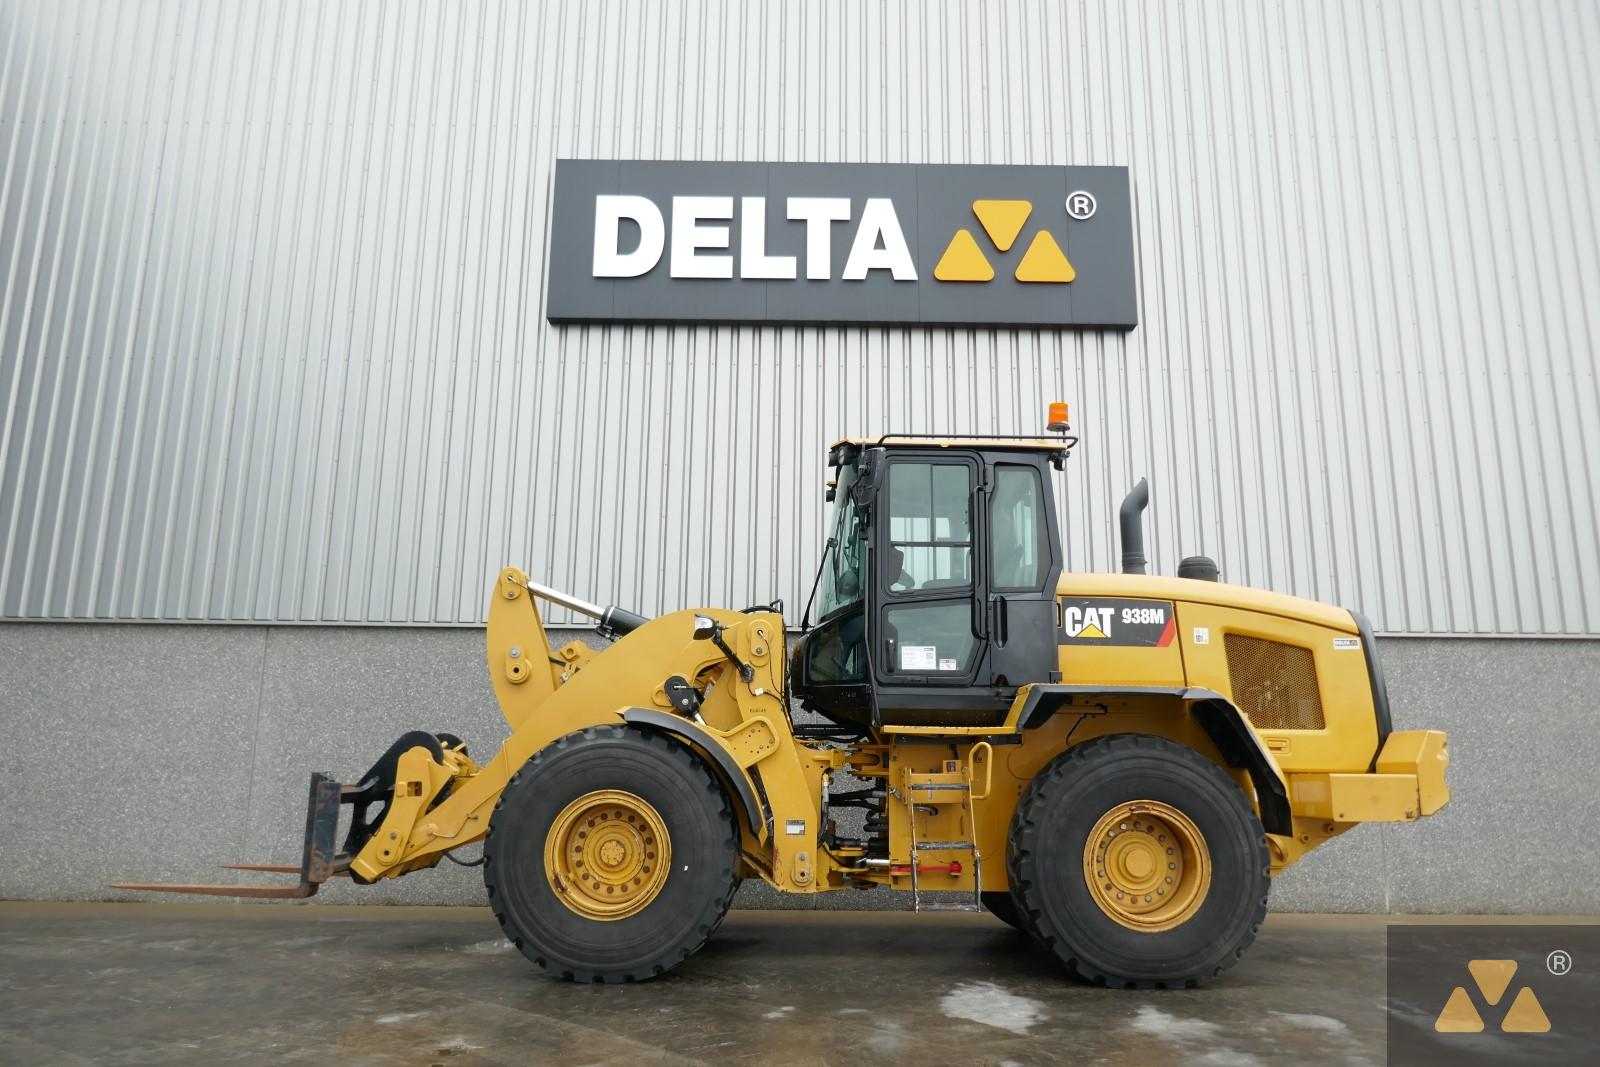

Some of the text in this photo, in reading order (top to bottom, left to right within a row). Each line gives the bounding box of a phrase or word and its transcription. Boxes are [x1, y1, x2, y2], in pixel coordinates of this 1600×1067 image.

[592, 194, 919, 281] DELTA
[1065, 606, 1165, 638] CAT 938M
